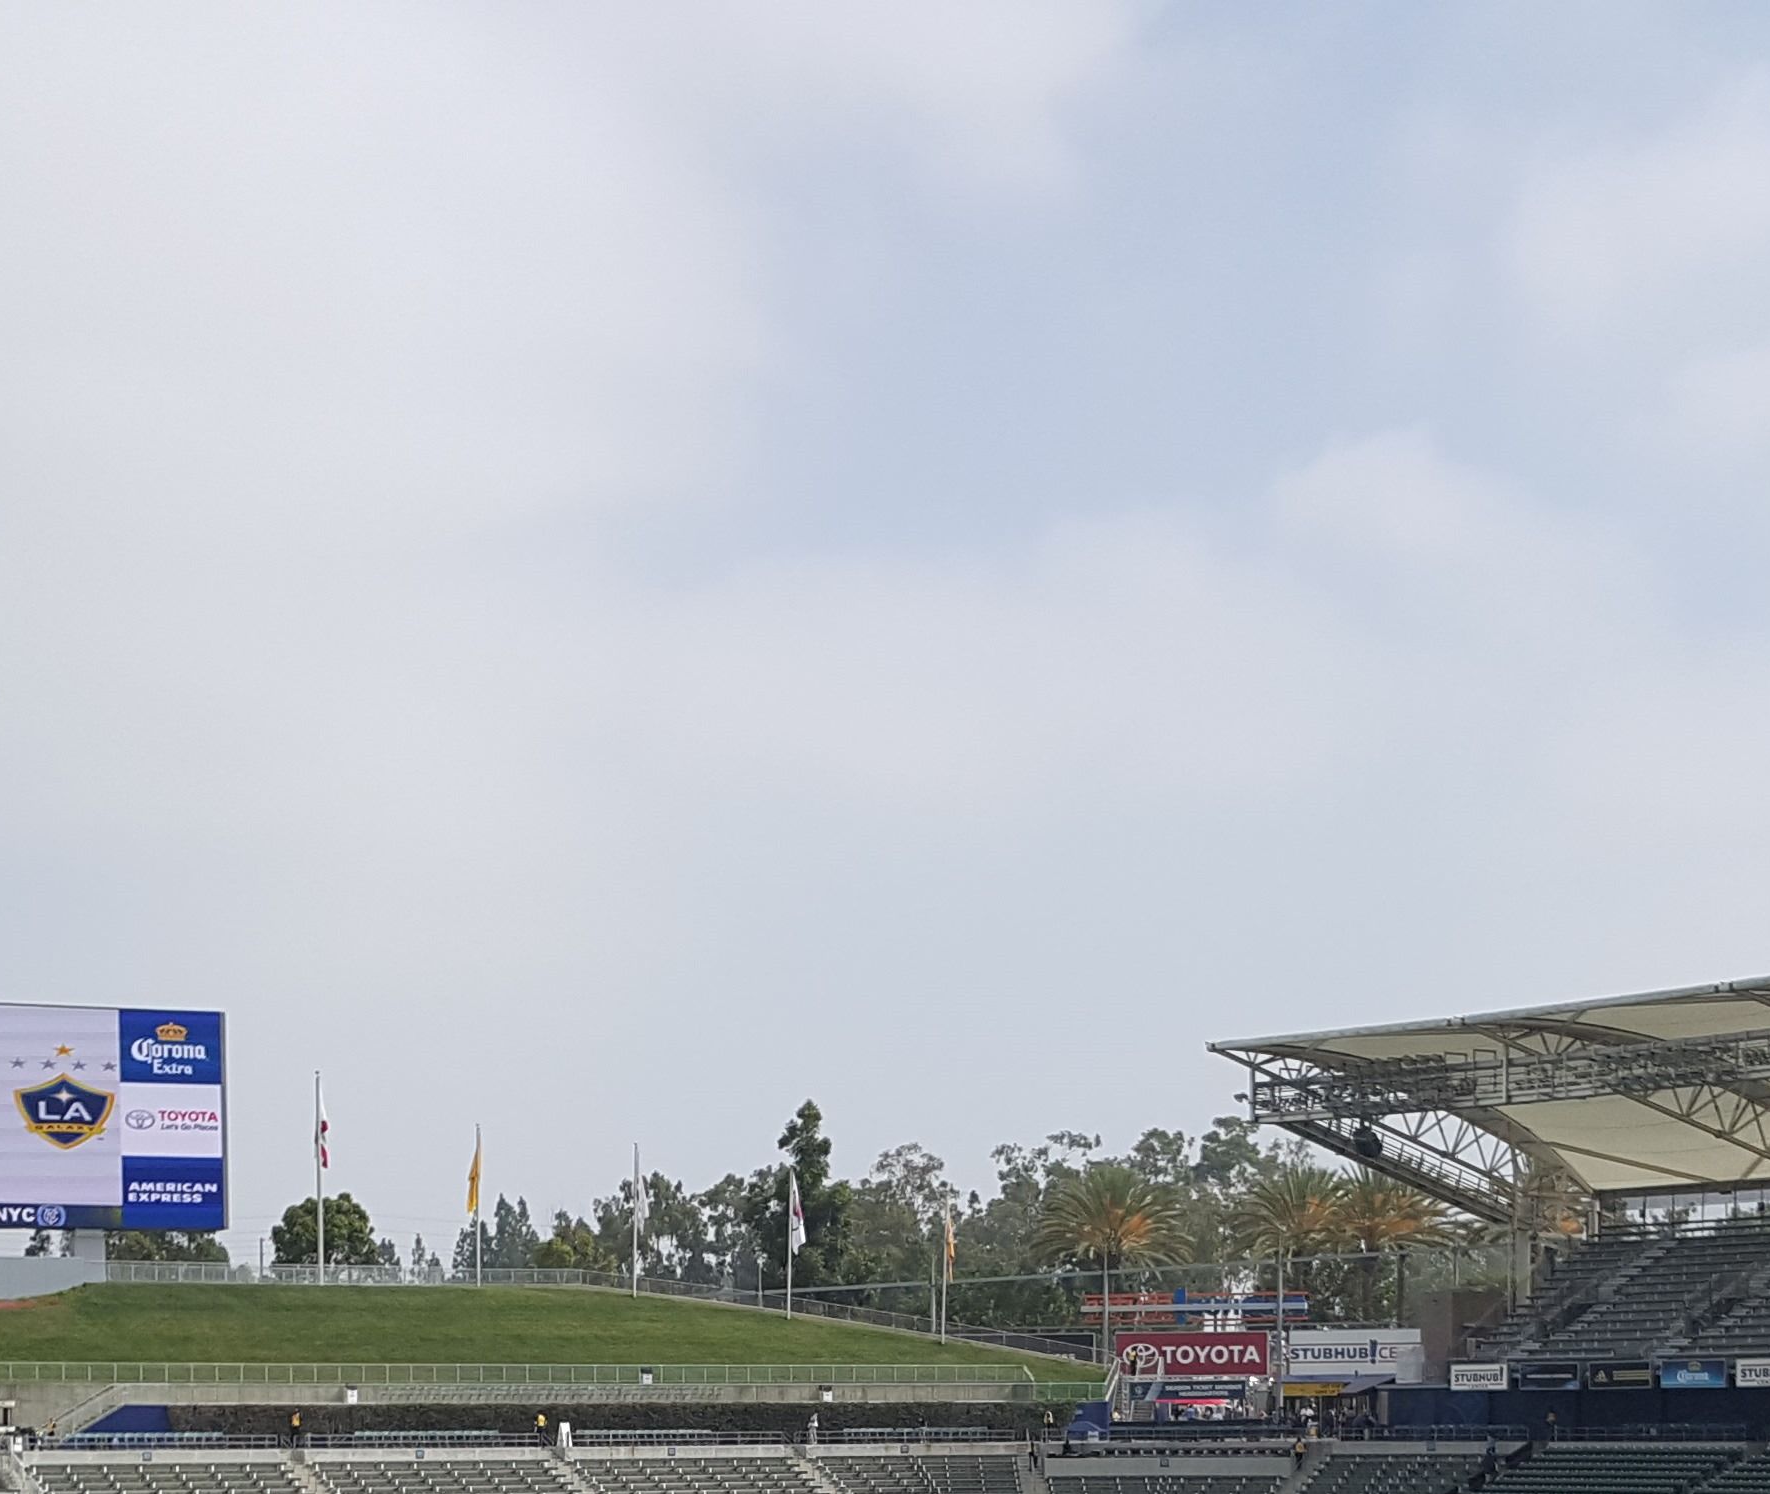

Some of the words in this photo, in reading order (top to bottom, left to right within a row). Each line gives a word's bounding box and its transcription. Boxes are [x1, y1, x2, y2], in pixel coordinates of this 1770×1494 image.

[131, 1038, 206, 1063] Corona
[153, 1058, 192, 1075] Extra
[38, 1101, 92, 1121] LA
[158, 1110, 218, 1123] TOYOTA
[129, 1182, 218, 1193] AMERICAN
[128, 1192, 203, 1204] EXPRESS
[1161, 1345, 1260, 1365] TOYOTA
